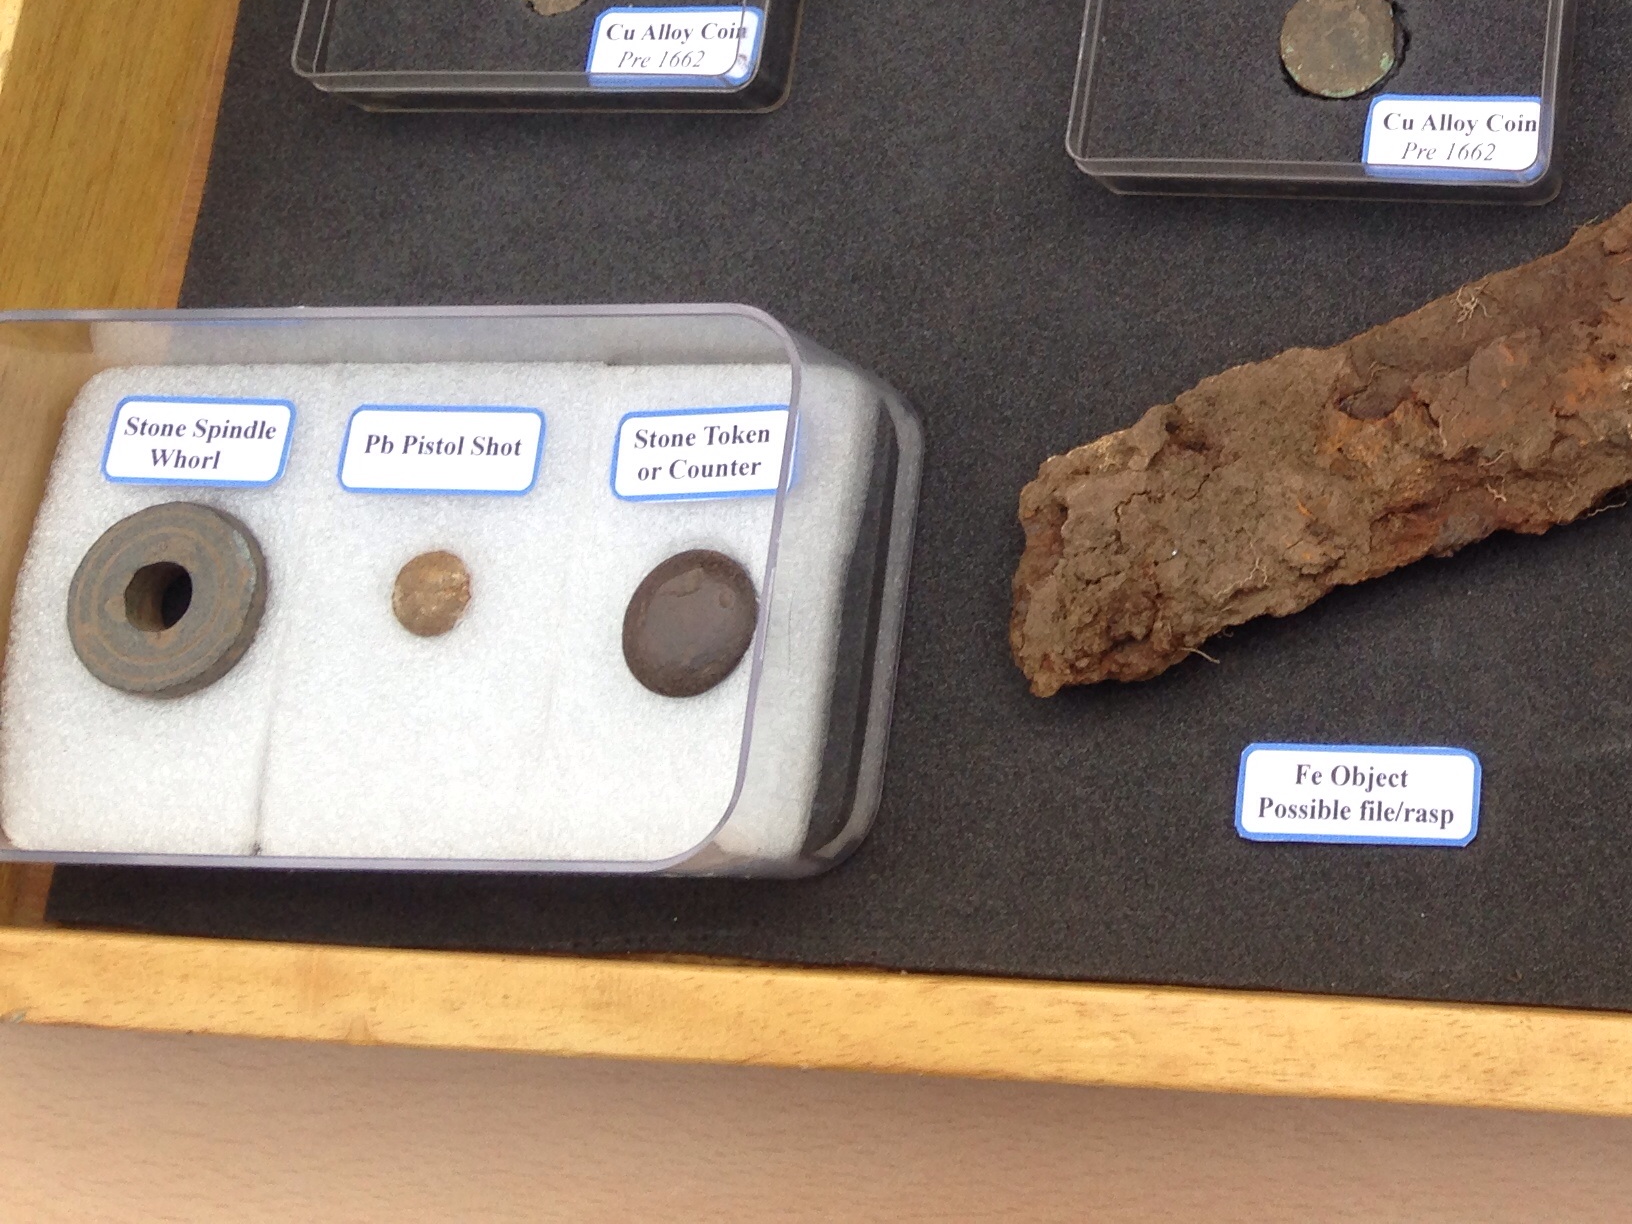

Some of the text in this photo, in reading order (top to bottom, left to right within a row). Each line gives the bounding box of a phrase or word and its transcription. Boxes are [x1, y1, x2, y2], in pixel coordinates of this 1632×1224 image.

[606, 22, 746, 44] Cu Alloy Coin
[617, 51, 705, 68] Pre 1662
[1383, 113, 1536, 135] Cu Alloy Coin
[1402, 142, 1496, 161] Pre 1662
[124, 417, 276, 443] Stone Spindle
[634, 425, 769, 448] Stone Token
[365, 435, 521, 456] Pb Pistol Shot
[151, 449, 220, 469] Whorl
[638, 459, 761, 480] or Counter
[1296, 764, 1408, 792] Fe Object
[1259, 797, 1454, 829] Possible file/rasp
